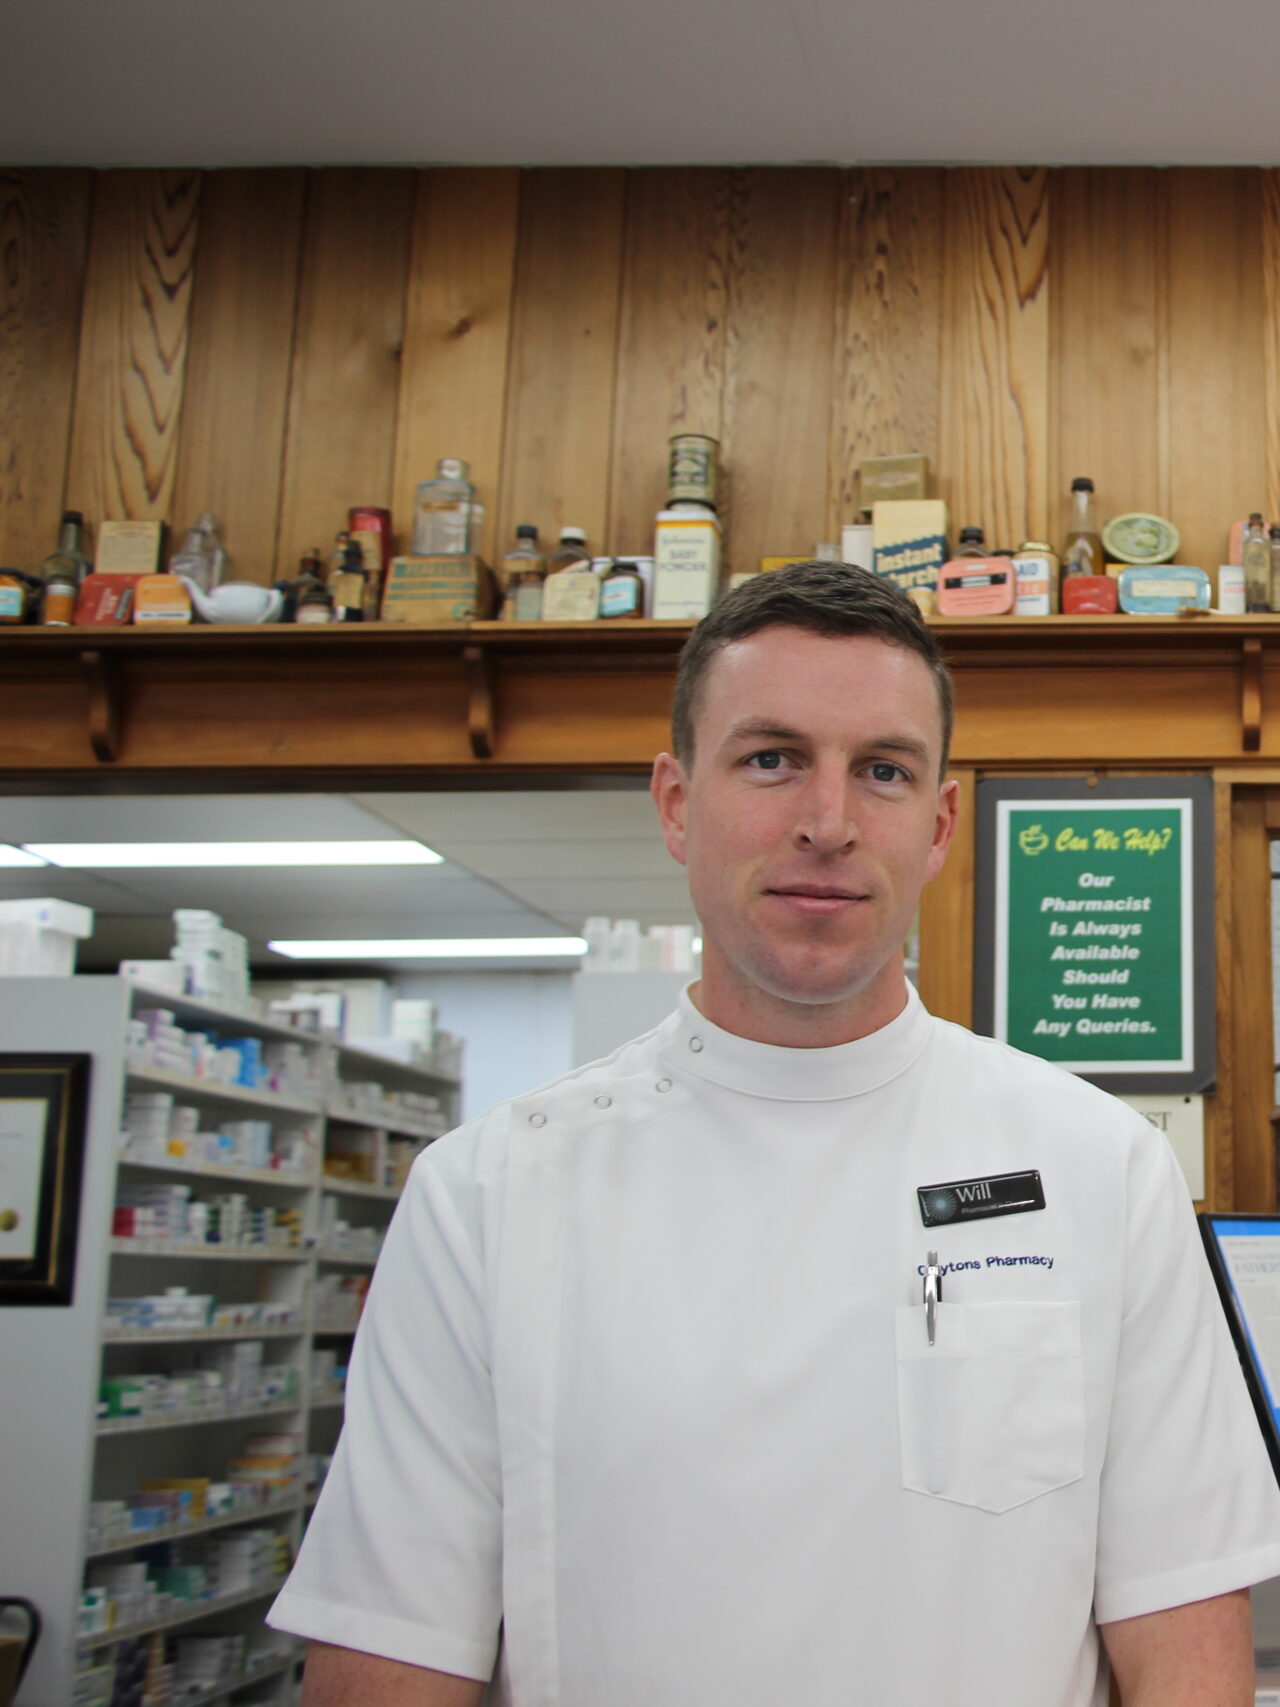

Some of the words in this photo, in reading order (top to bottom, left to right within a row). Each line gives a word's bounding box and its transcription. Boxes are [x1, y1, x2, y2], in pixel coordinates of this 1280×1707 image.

[669, 550, 697, 560] BABY
[877, 543, 942, 574] instant
[658, 562, 709, 572] POWDER
[888, 565, 939, 588] tarch
[1055, 827, 1089, 851] Can
[1093, 827, 1120, 850] We
[1123, 827, 1173, 856] Help?
[1078, 872, 1115, 888] Our
[1040, 896, 1151, 912] Pharmacist
[1049, 921, 1068, 936] Is
[1071, 921, 1142, 938] Always
[1050, 945, 1140, 961] Available
[1062, 969, 1129, 985] Should
[1051, 994, 1086, 1009] You
[1091, 993, 1141, 1009] Have
[1033, 1019, 1070, 1037] Any
[1076, 1018, 1156, 1035] Queries.
[955, 1182, 992, 1203] Will
[917, 1261, 981, 1277] Cytons
[986, 1255, 1054, 1269] Pharmacy
